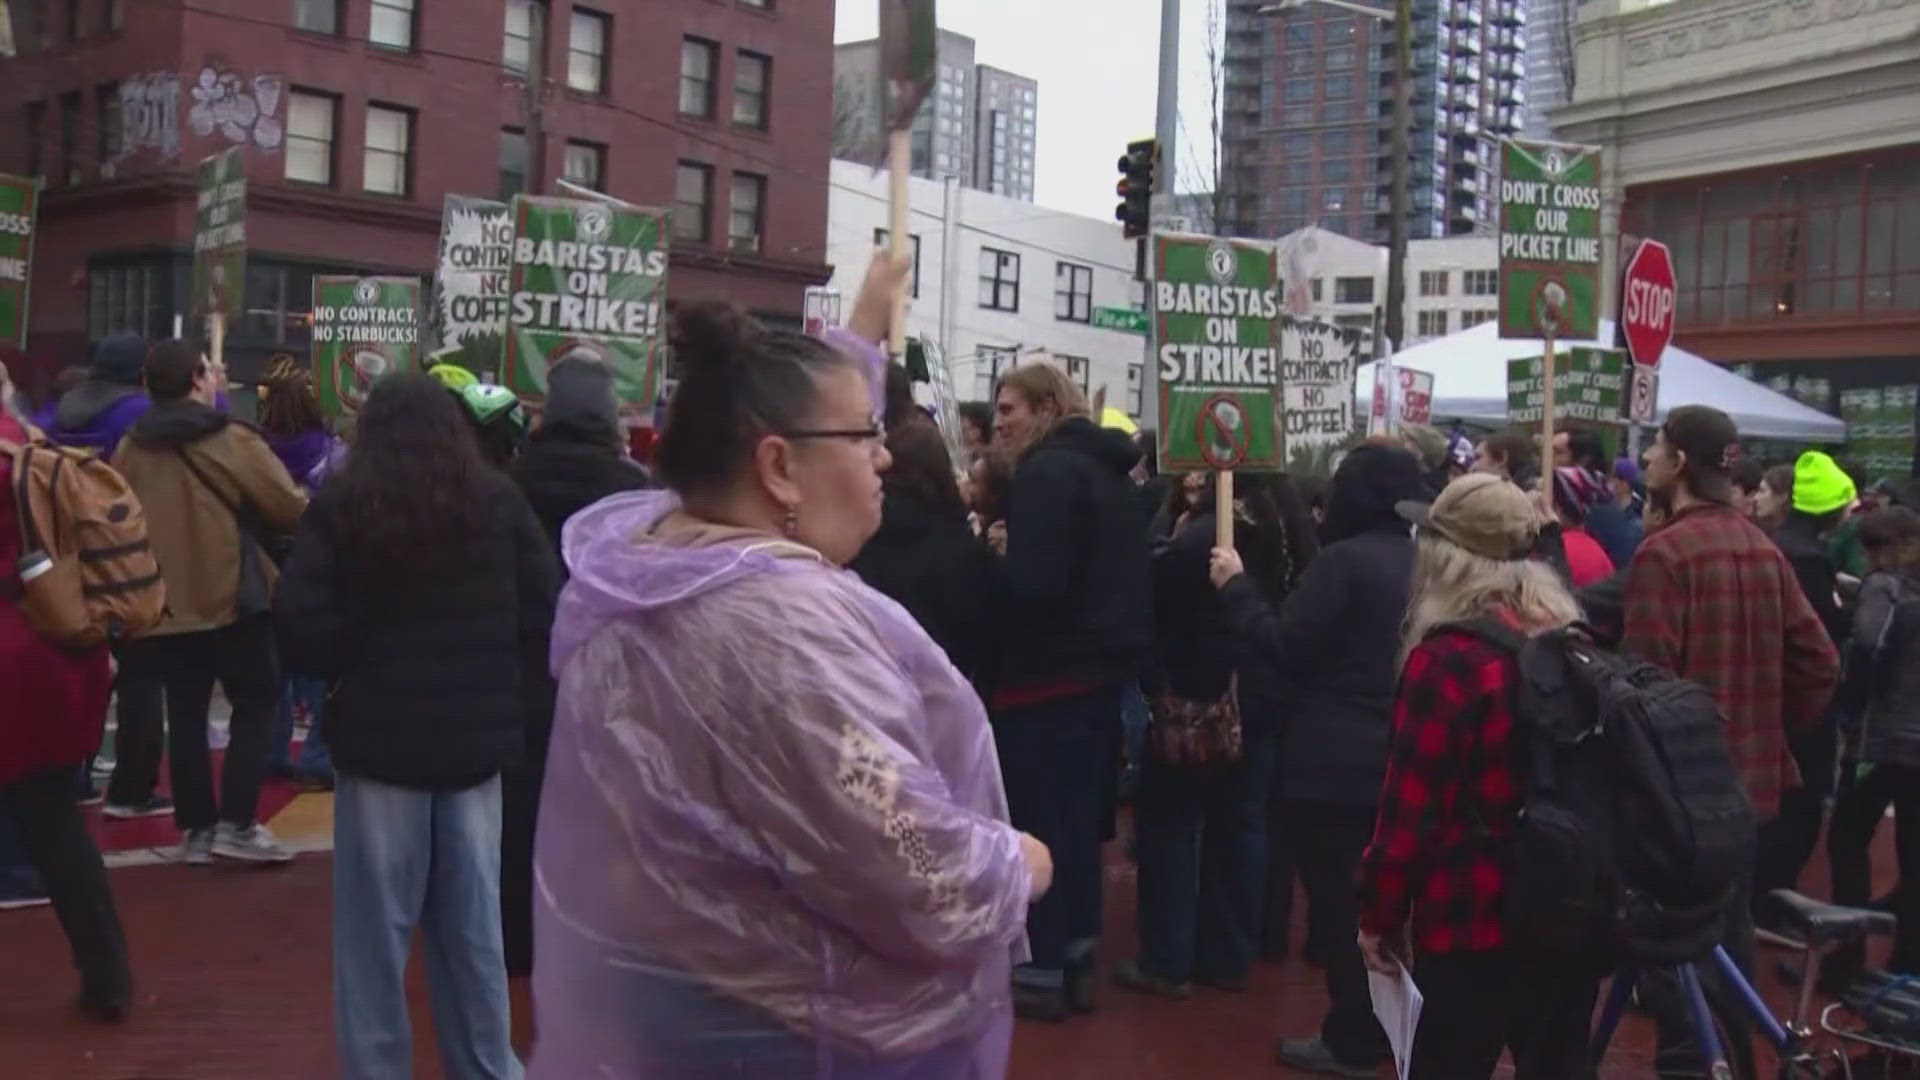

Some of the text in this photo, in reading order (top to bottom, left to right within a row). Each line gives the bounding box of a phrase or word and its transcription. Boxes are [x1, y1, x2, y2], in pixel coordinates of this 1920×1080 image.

[1502, 180, 1600, 209] DON'T CROSS
[1535, 209, 1568, 232] OUR
[514, 237, 665, 277] BARISTAS
[1502, 233, 1599, 263] PICKET LINE
[568, 272, 609, 297] ON
[511, 292, 658, 334] STRIKE!
[1157, 281, 1277, 318] BARISTAS
[1628, 278, 1672, 330] STOP
[315, 307, 417, 324] NO CONTRACT,
[314, 326, 418, 343] NO STARBUCKS!
[1206, 319, 1238, 343] ON
[1301, 340, 1323, 358] NO
[1160, 344, 1276, 383] STRIKE!
[1283, 361, 1349, 380] CONTRACT?
[1303, 388, 1324, 406] NO
[1284, 402, 1346, 433] COFFEE!
